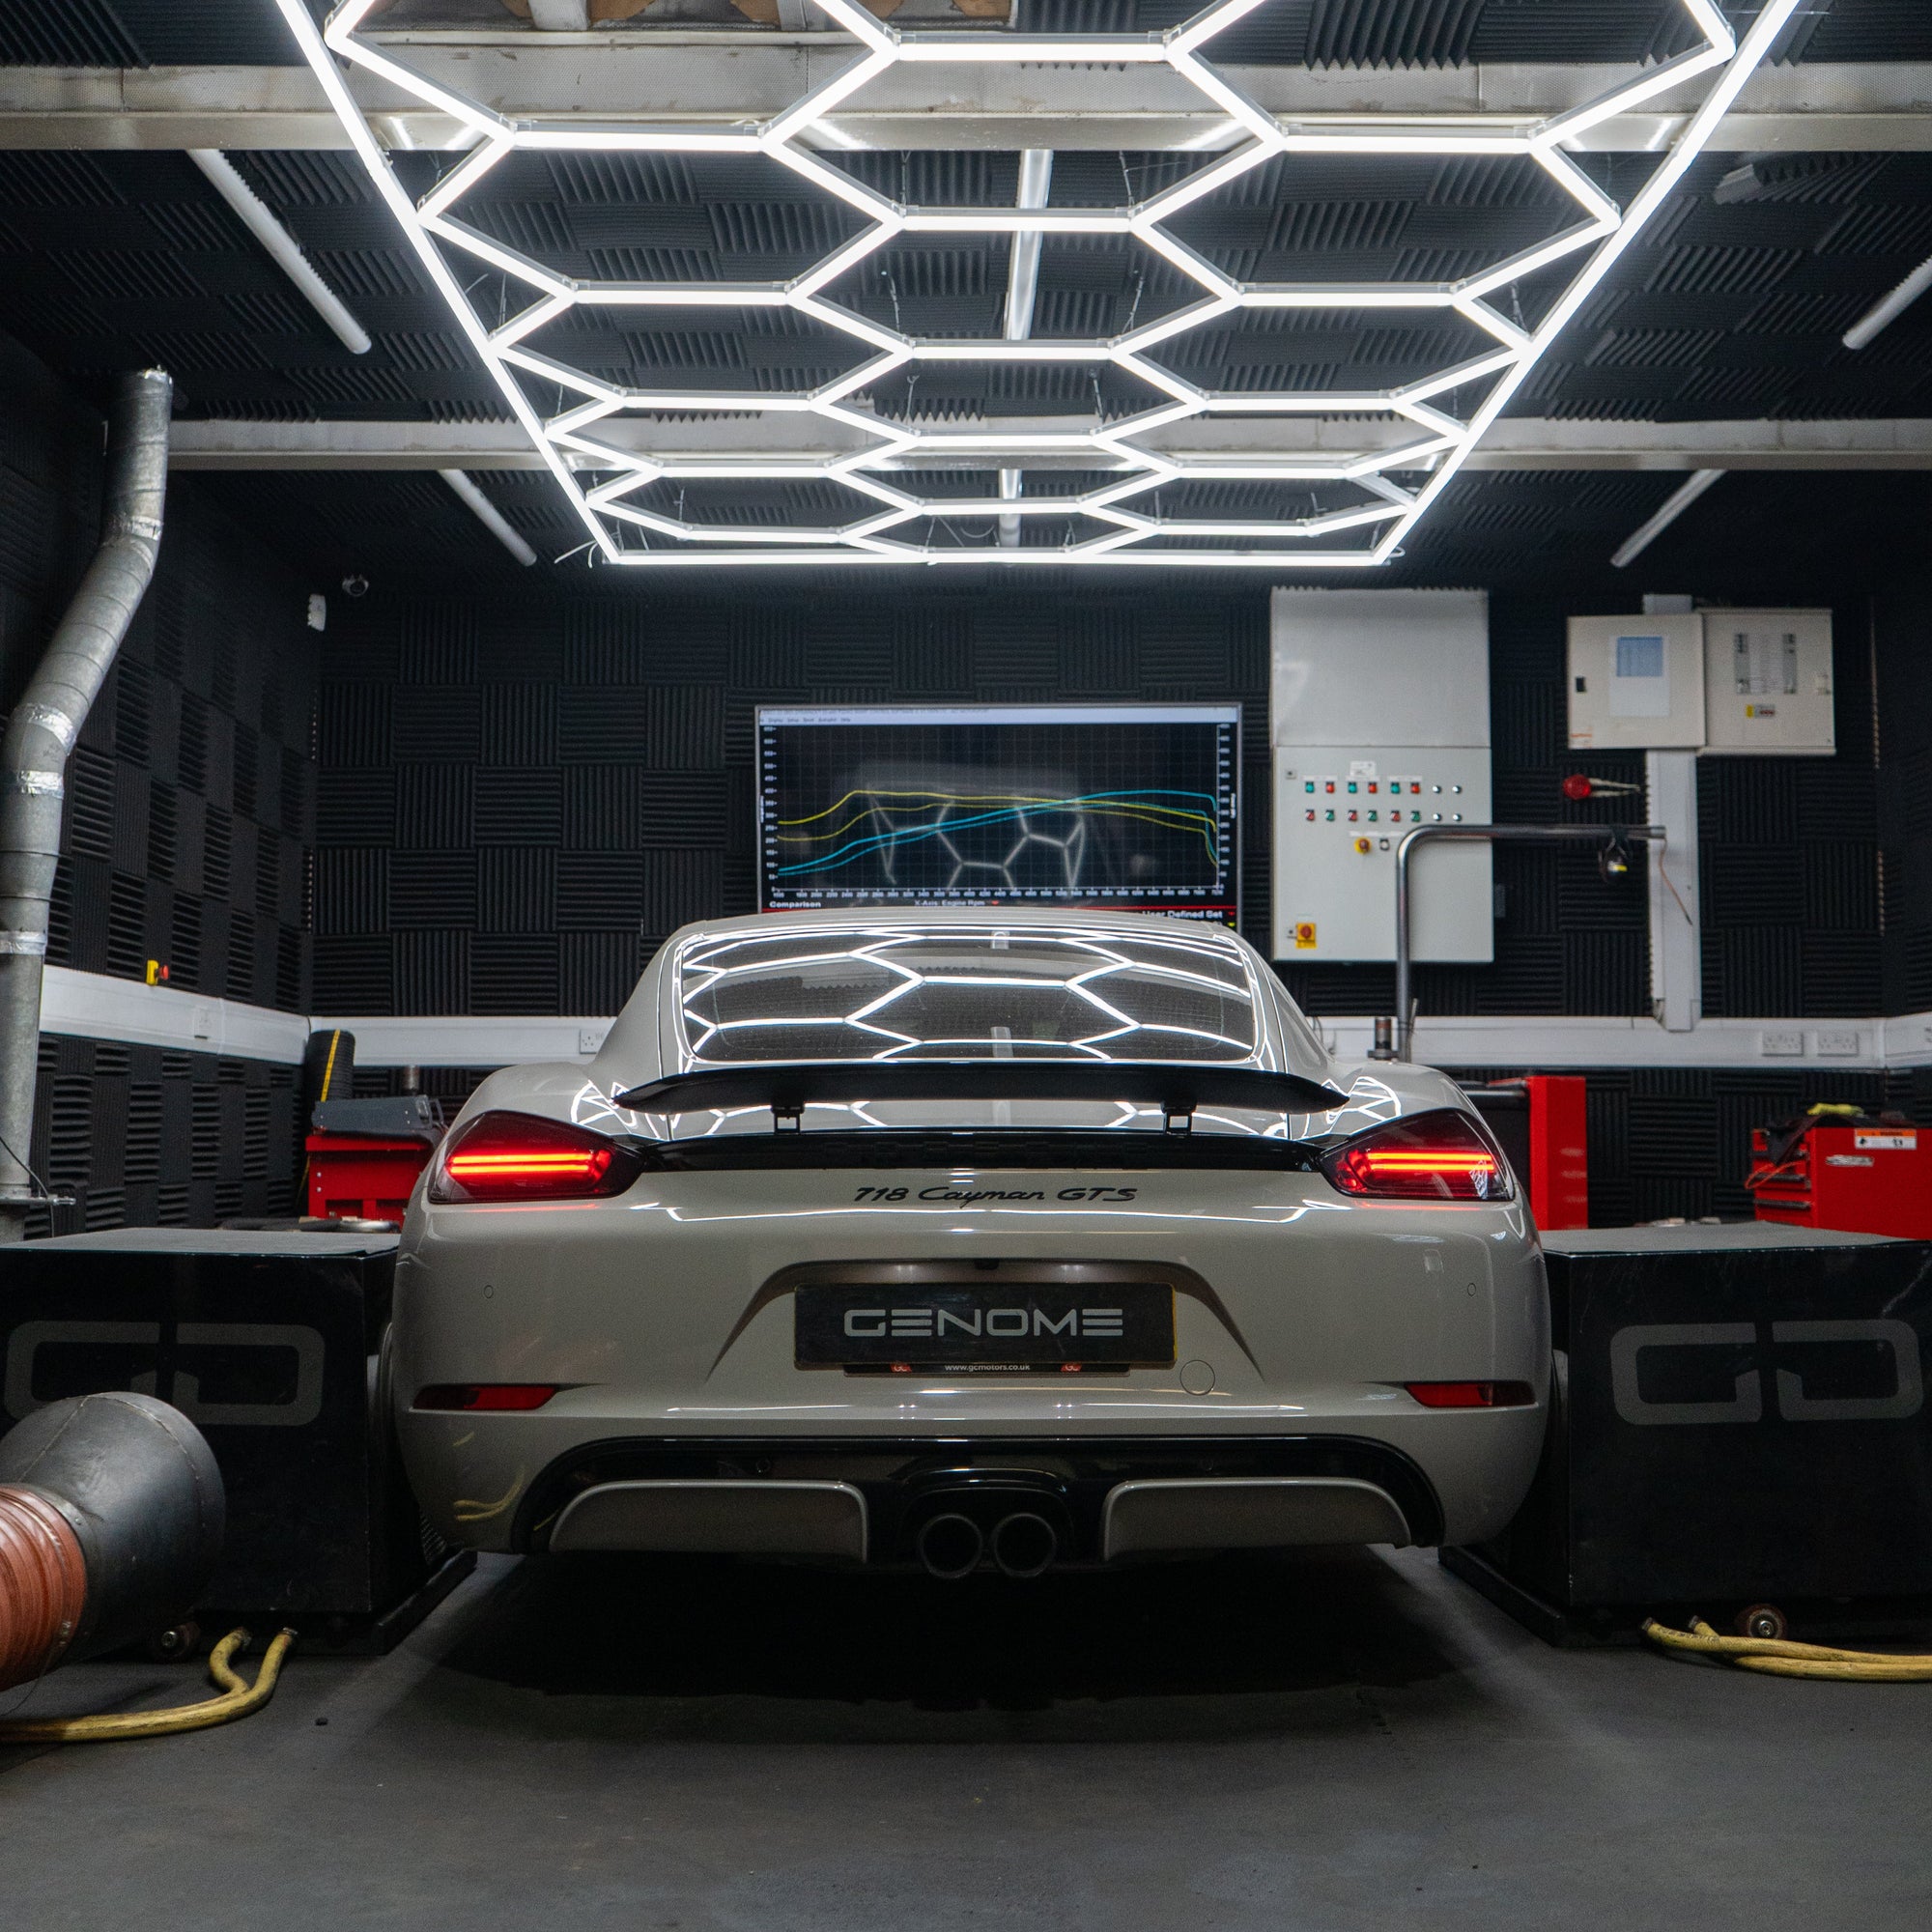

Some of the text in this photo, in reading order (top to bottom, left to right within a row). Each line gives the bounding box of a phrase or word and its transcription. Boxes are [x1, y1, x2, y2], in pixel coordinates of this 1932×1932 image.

[769, 900, 822, 909] Comparison
[1167, 910, 1205, 919] Defined
[1206, 910, 1223, 919] Set
[854, 1186, 1138, 1209] 718 Cayman GTS
[843, 1308, 1123, 1337] GENOME
[944, 1364, 1031, 1373] www.gcmotors.co.uk
